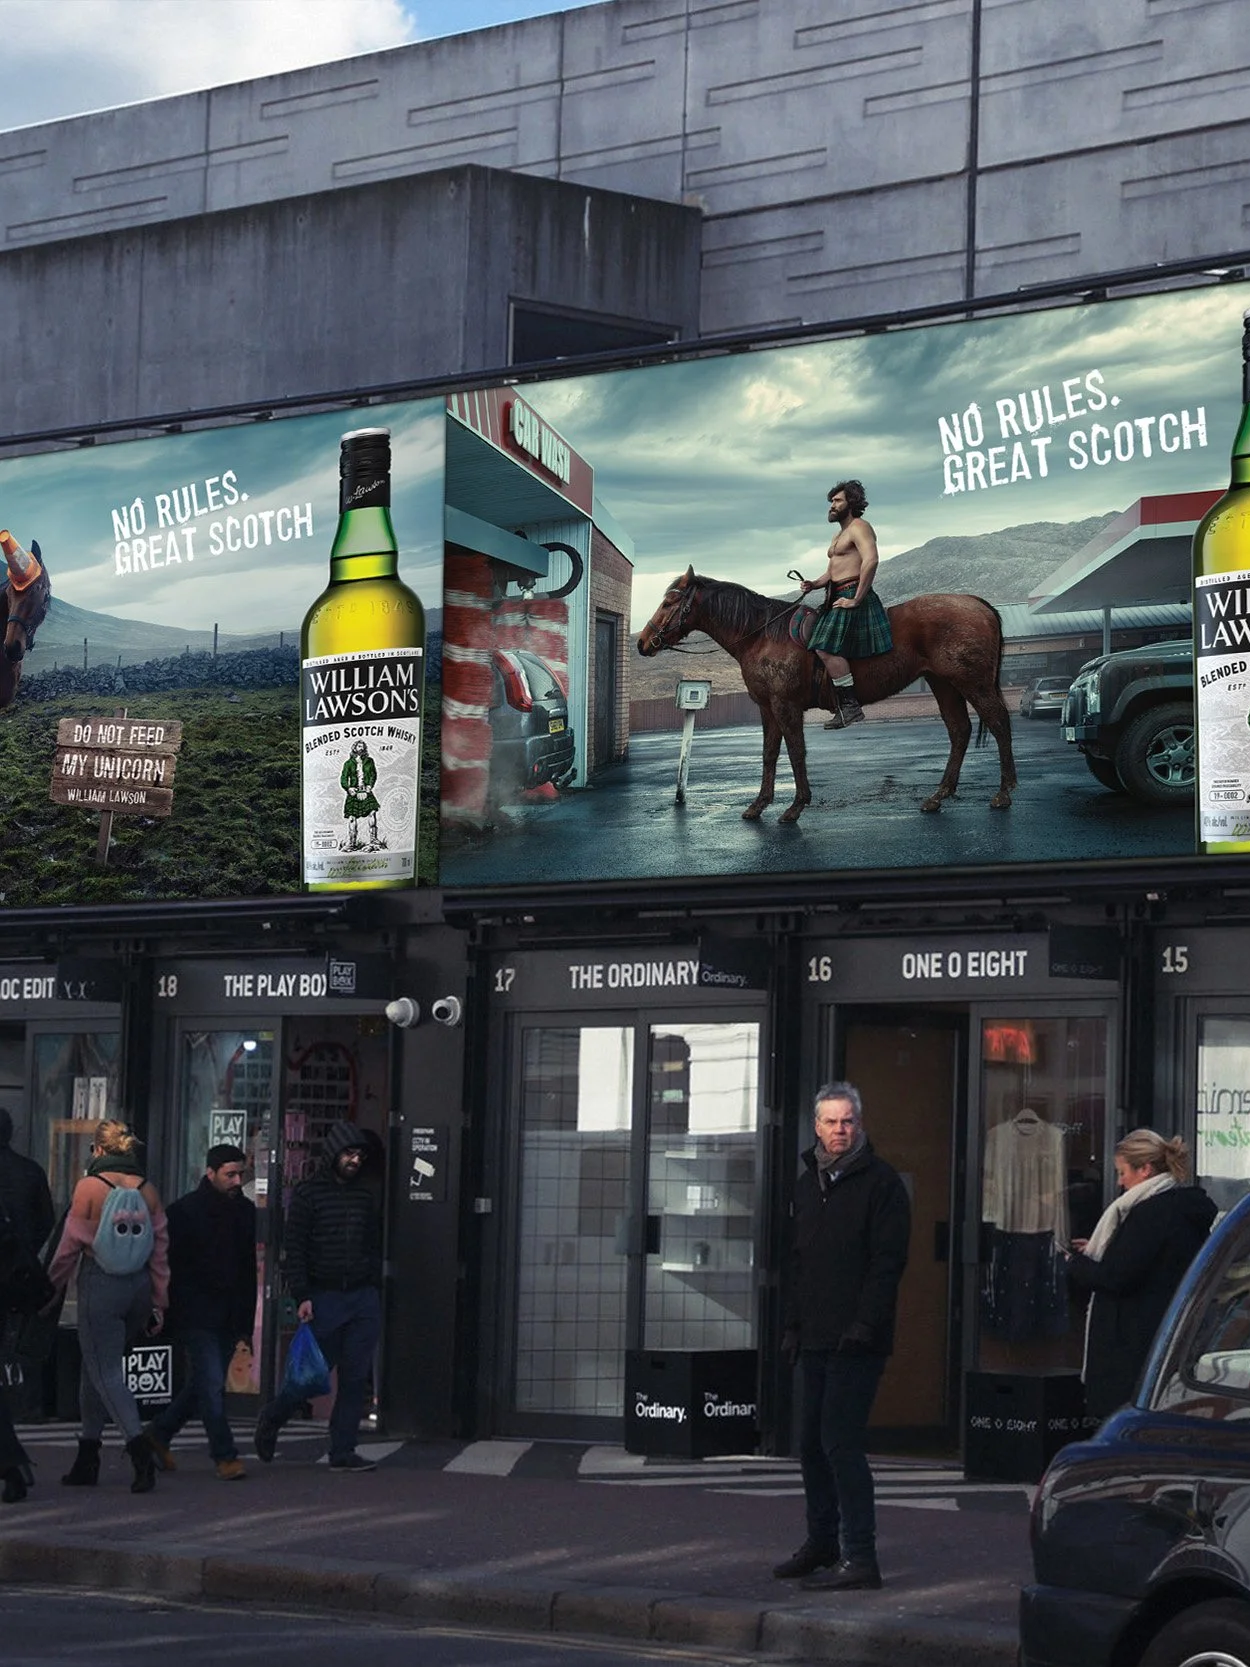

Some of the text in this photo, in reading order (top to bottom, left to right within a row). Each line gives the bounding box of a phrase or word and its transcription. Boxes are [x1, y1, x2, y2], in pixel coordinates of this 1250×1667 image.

[938, 369, 1120, 455] NO RULES.
[513, 398, 570, 485] CAR WASH
[943, 406, 1208, 495] GREAT SCOTCH
[111, 470, 249, 542] NO RULES.
[114, 502, 314, 576] GREAT SCOTCH
[309, 663, 414, 695] WILLIAM
[1200, 660, 1247, 688] BLENDED
[306, 688, 419, 721] LAWSON'S
[74, 724, 164, 746] DO NOT FEED
[305, 726, 416, 753] BLENDED SCOTCH WHISKY
[61, 753, 166, 782] MY UNICORN
[67, 788, 147, 805] WILLIAM LAWSON
[808, 950, 1028, 981] 16 ONE O EIGHT
[1162, 946, 1188, 973] 15
[23, 977, 56, 999] EDIT
[158, 975, 178, 997] 18
[224, 975, 253, 997] THE
[257, 974, 297, 997] PLAY
[494, 960, 700, 992] 17 THE ORDINARY
[214, 1116, 243, 1134] PLAY
[128, 1352, 166, 1372] PLAY
[635, 1401, 687, 1423] Ordinary.
